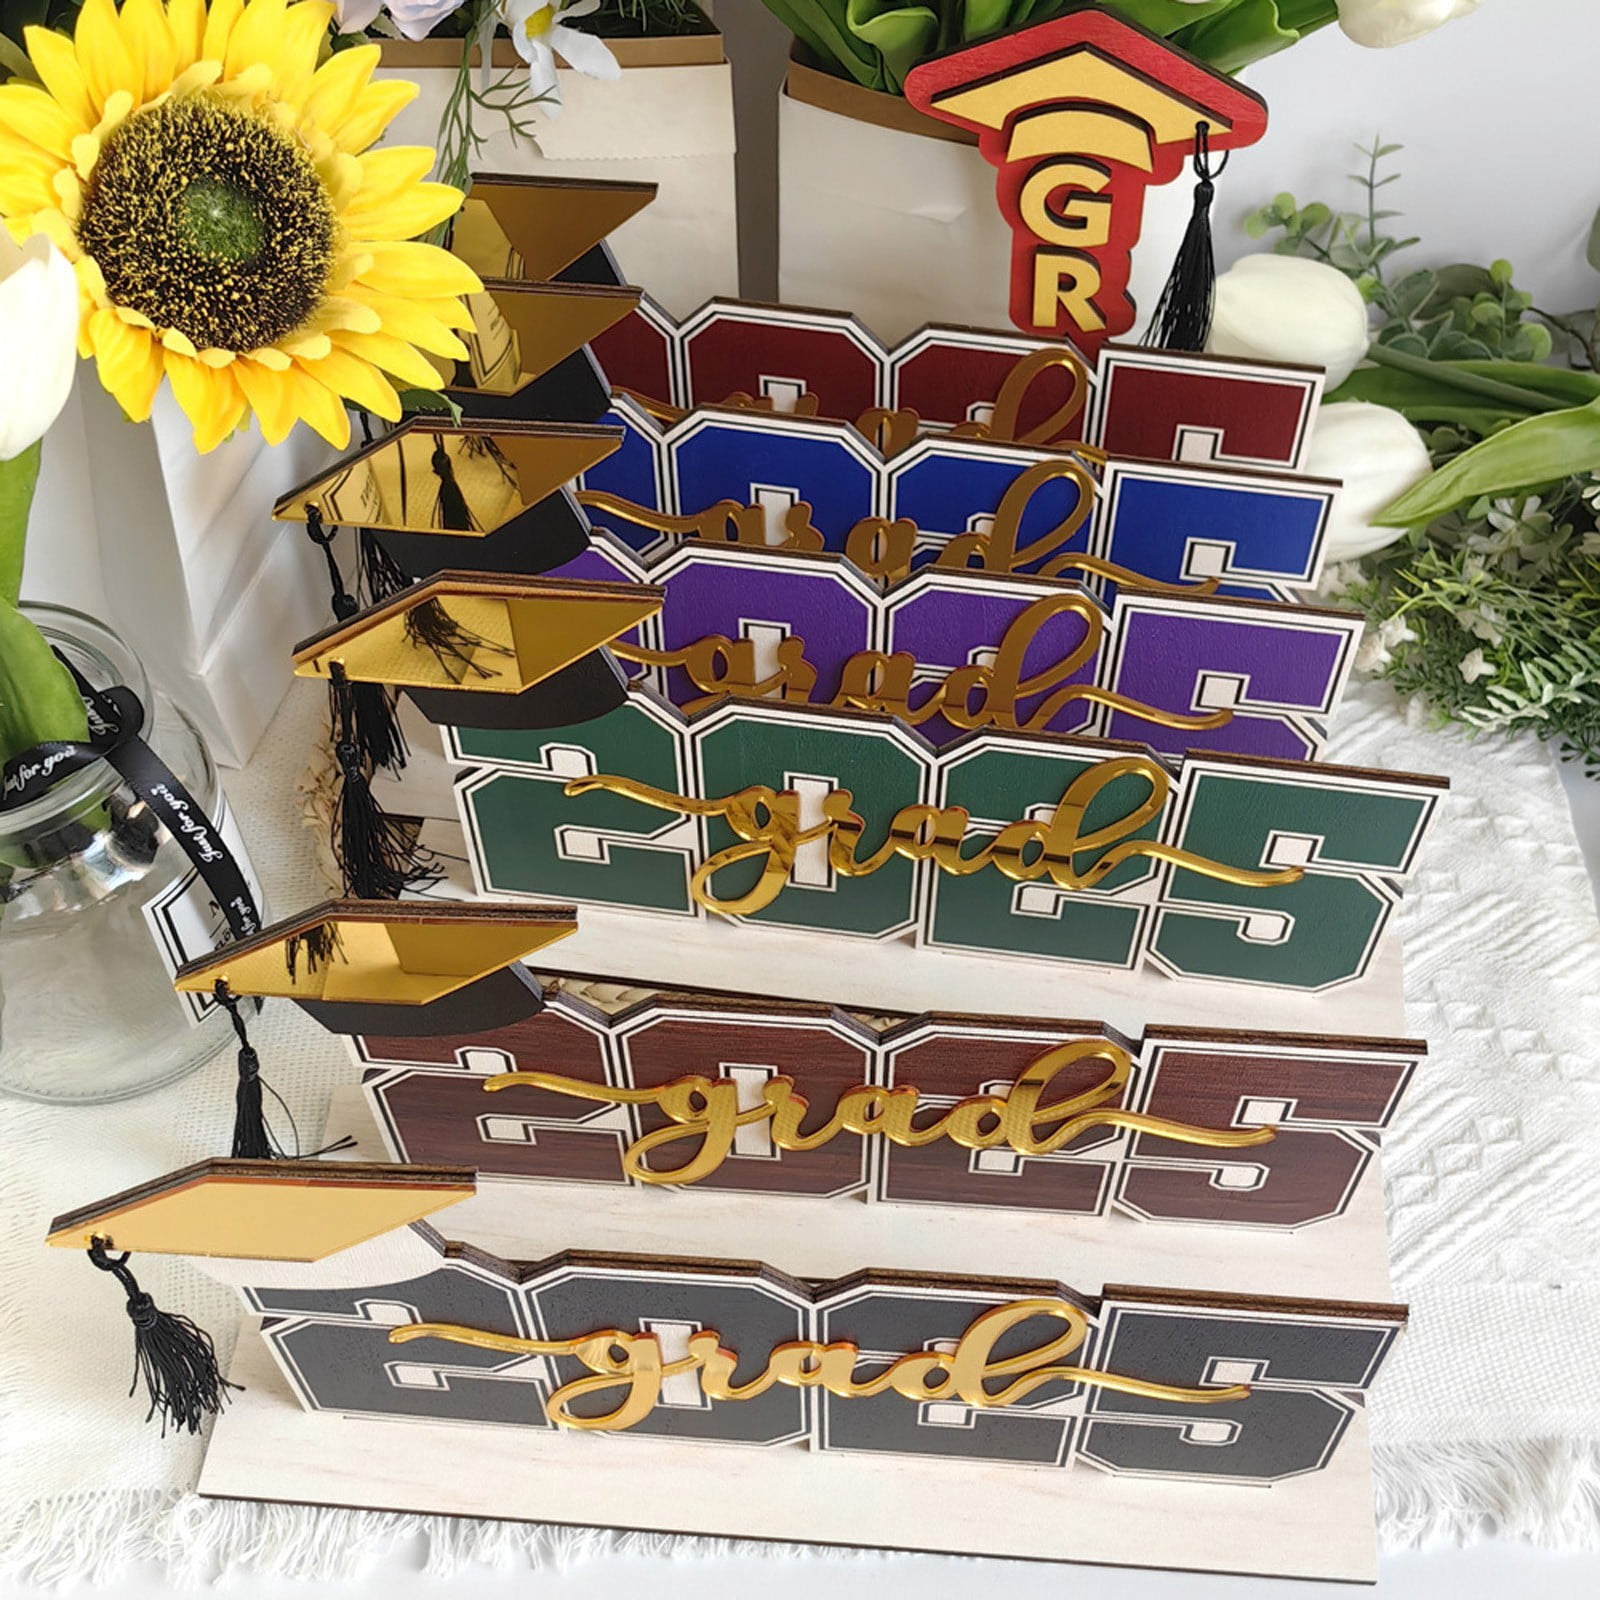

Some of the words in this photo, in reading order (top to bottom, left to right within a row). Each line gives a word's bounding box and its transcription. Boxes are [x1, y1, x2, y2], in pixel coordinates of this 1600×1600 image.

[441, 693, 1447, 996] 2025
[563, 756, 1304, 916] grad
[343, 1002, 1426, 1232] 2025
[482, 1037, 1276, 1185] grad
[243, 1258, 1407, 1484] 2025
[388, 1300, 1250, 1431] grad
